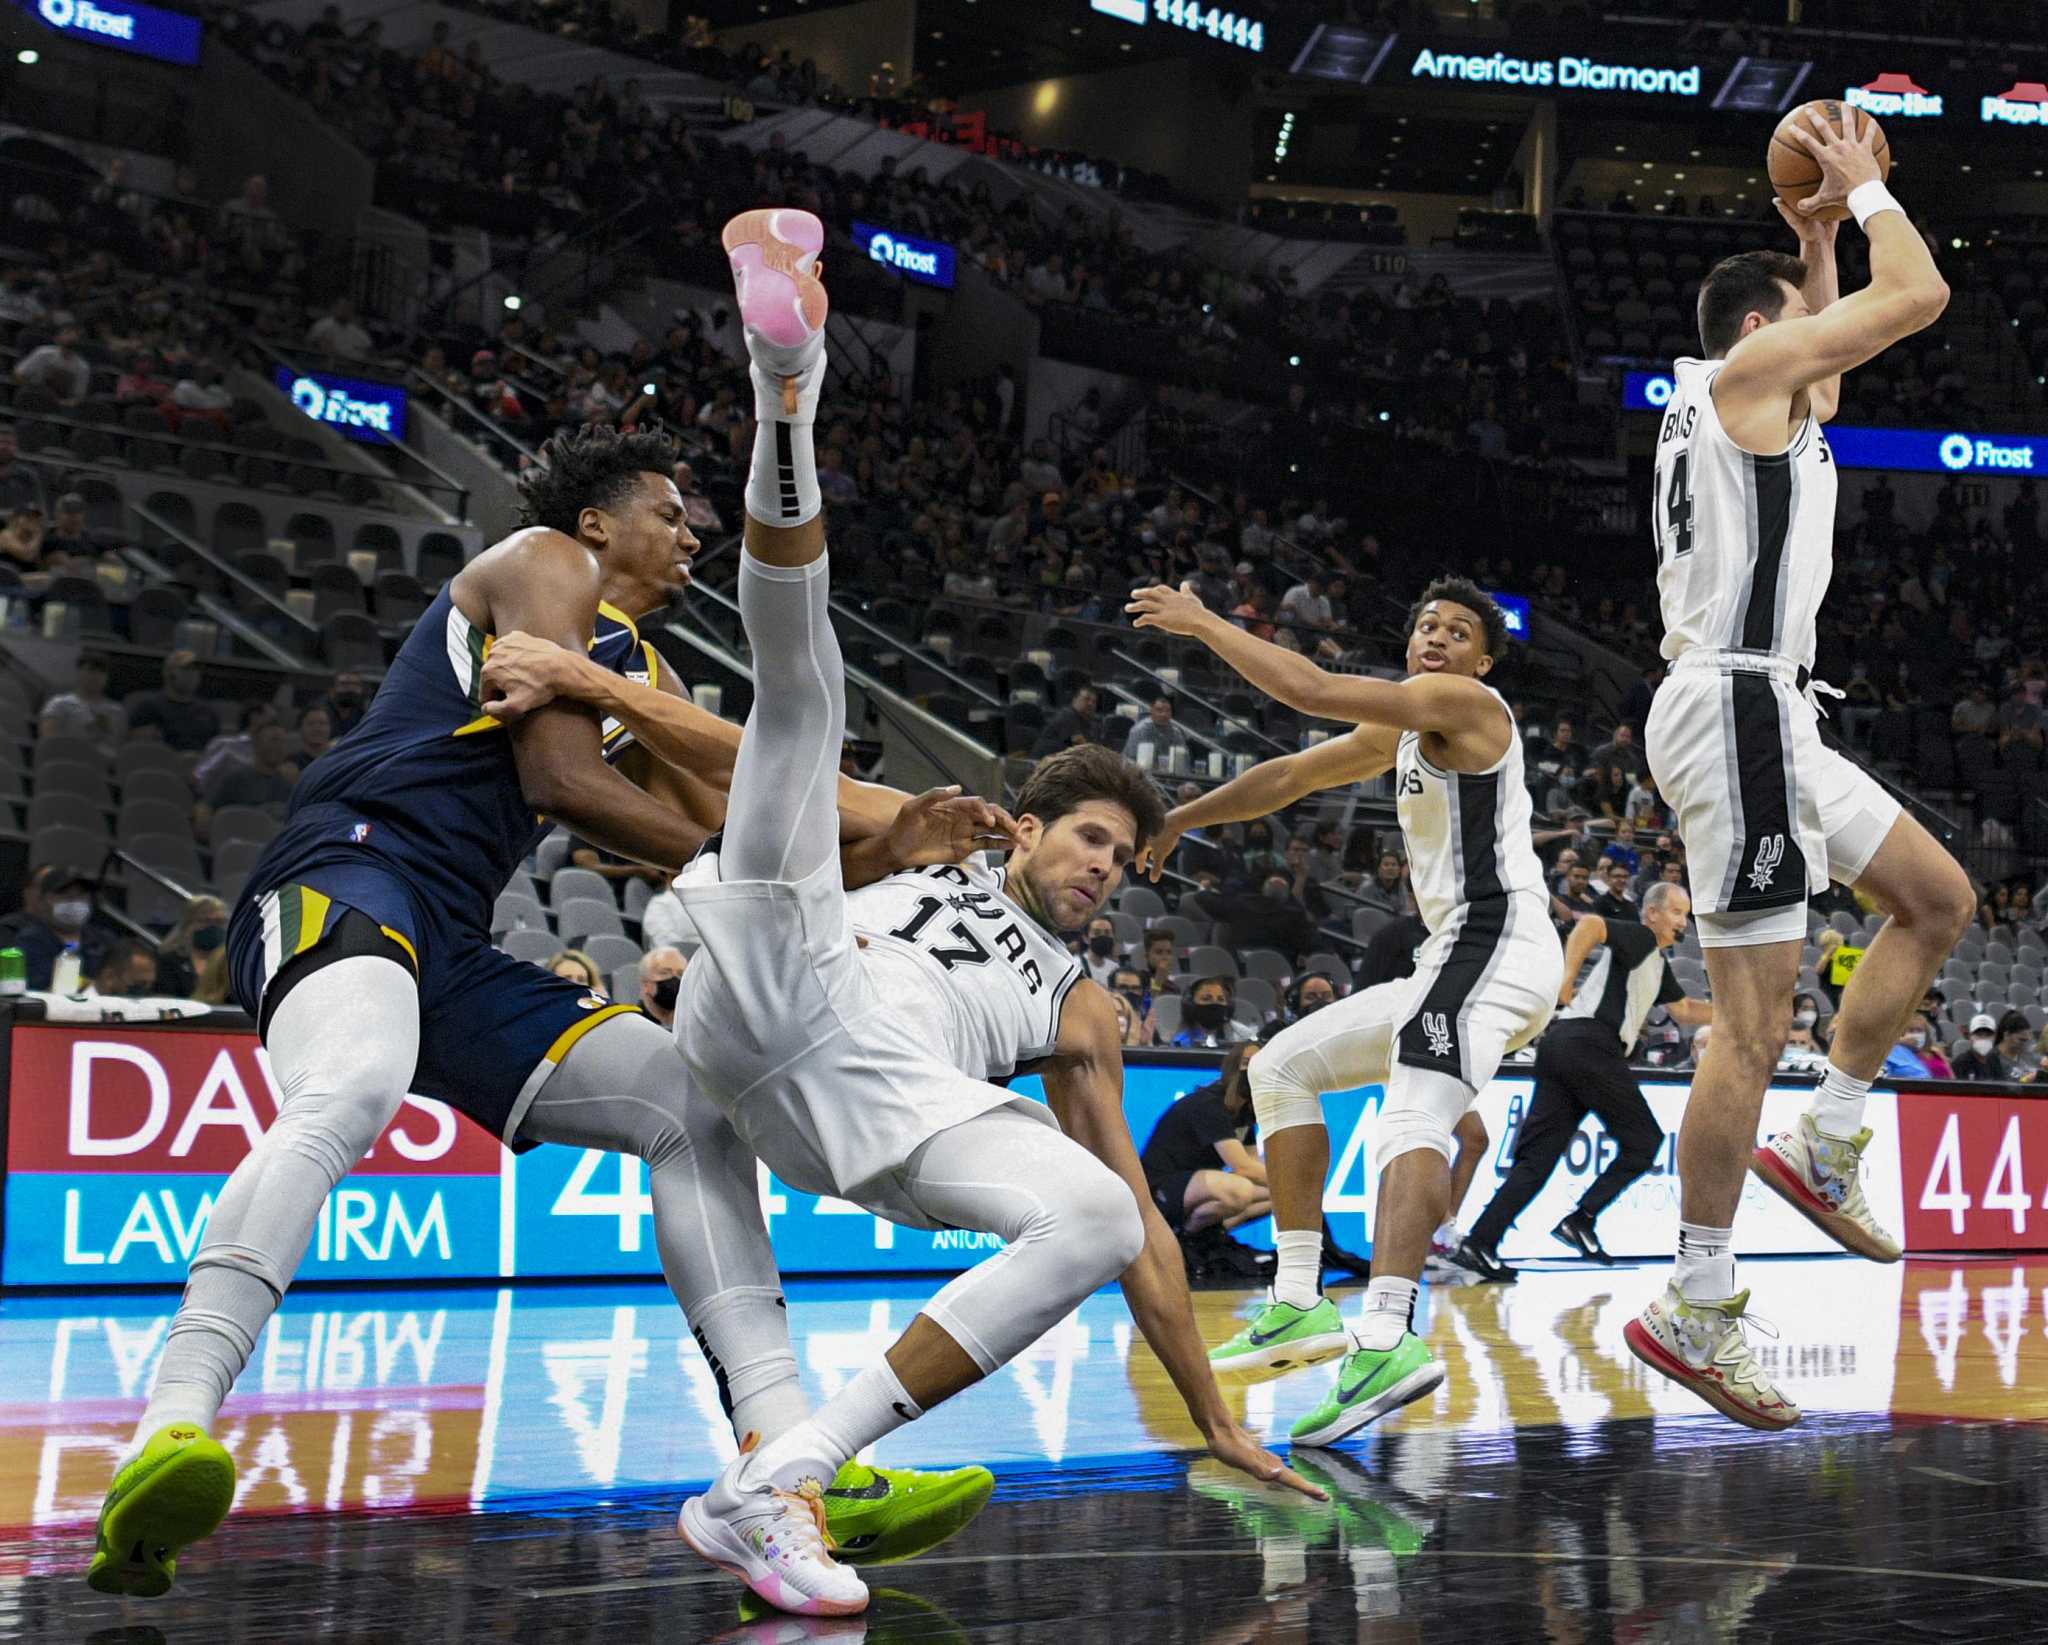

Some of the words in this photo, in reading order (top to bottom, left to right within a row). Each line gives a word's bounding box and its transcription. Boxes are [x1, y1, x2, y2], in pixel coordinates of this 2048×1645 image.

[73, 0, 135, 40] Frost
[1411, 48, 1554, 86] Americus
[1558, 56, 1701, 95] Diamond
[895, 242, 939, 275] Frost
[1975, 440, 2034, 469] Frost
[889, 895, 993, 972] 17
[69, 1041, 457, 1162] DAS
[1918, 1112, 2048, 1235] 44
[317, 1189, 453, 1261] IRM
